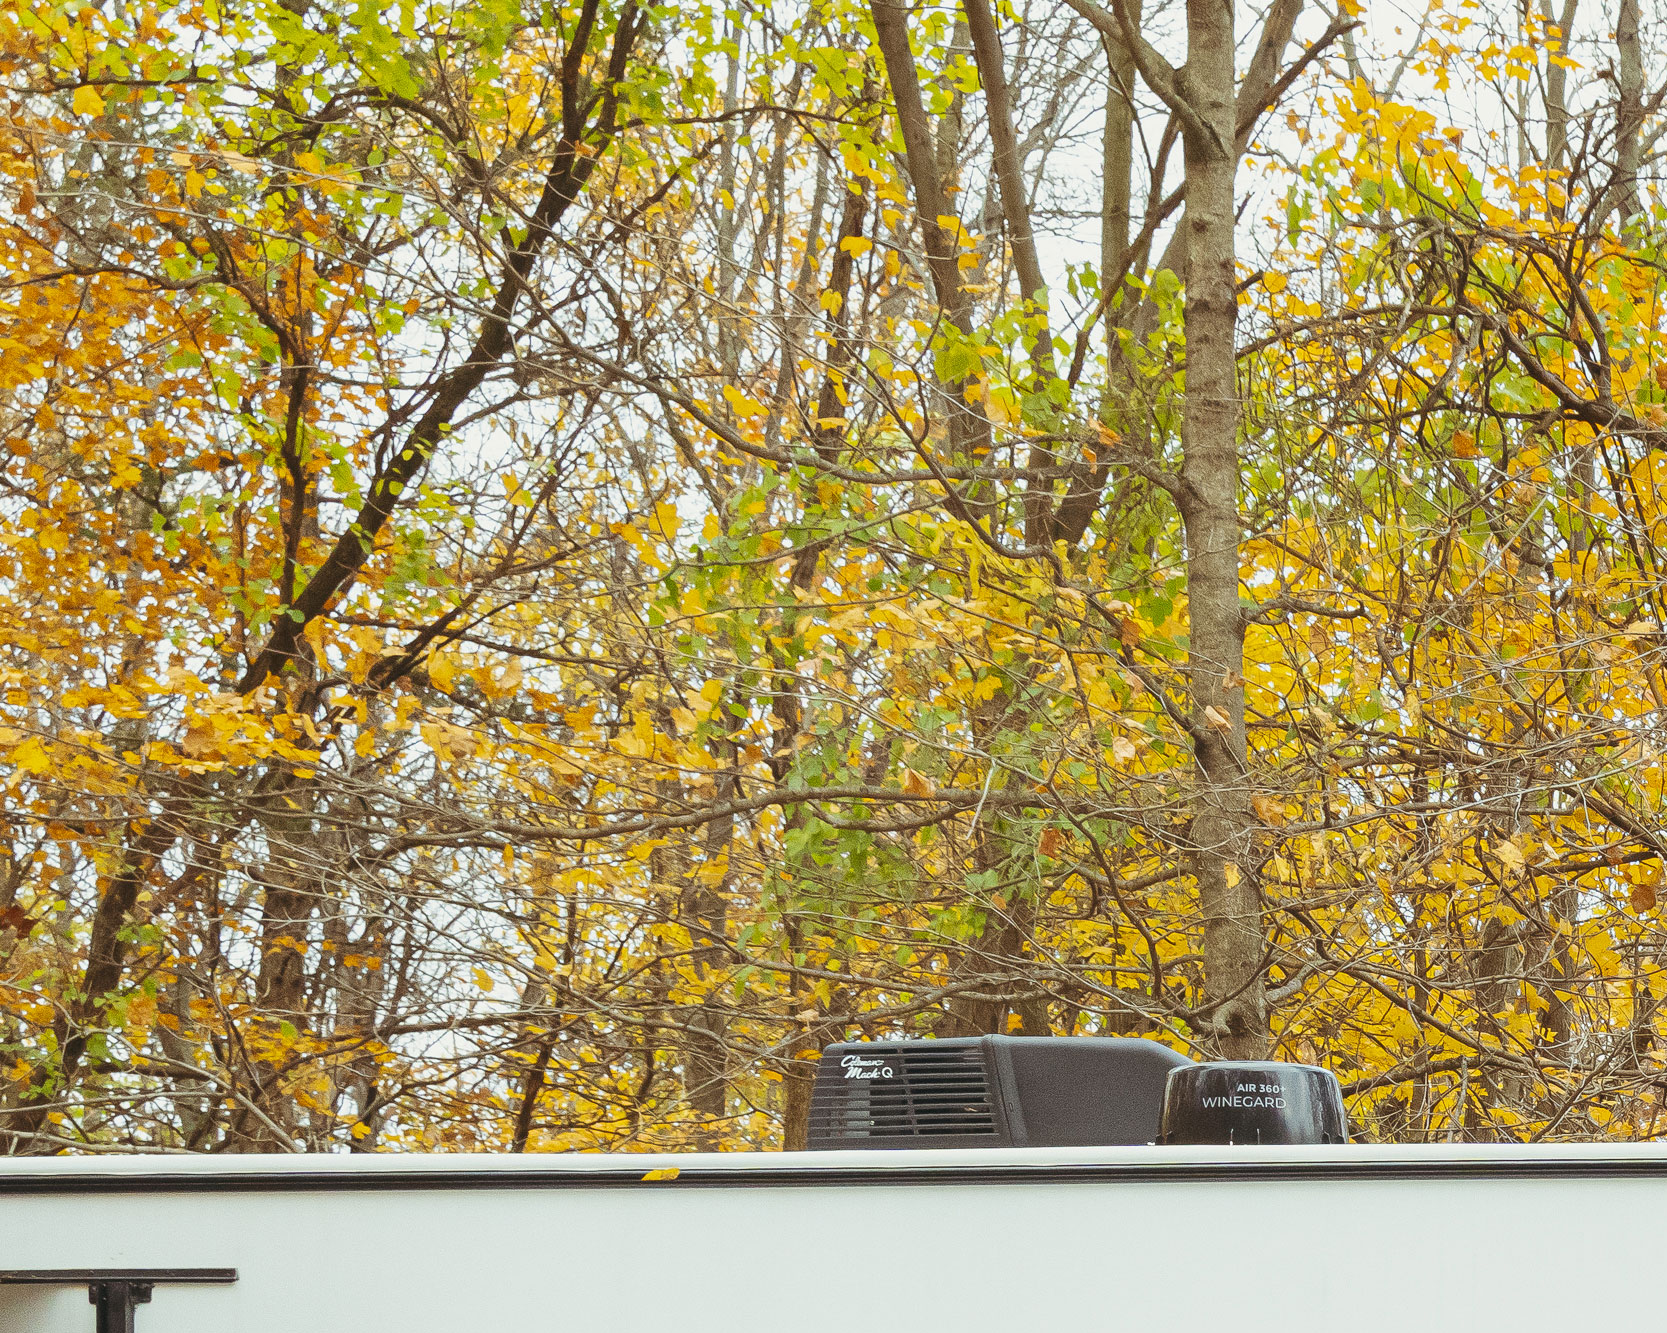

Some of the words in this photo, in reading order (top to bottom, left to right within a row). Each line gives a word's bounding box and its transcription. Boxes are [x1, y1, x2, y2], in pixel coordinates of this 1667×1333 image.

[841, 1055, 884, 1067] Coleman
[1237, 1084, 1257, 1092] AIR
[1202, 1096, 1287, 1108] WINEGARD
